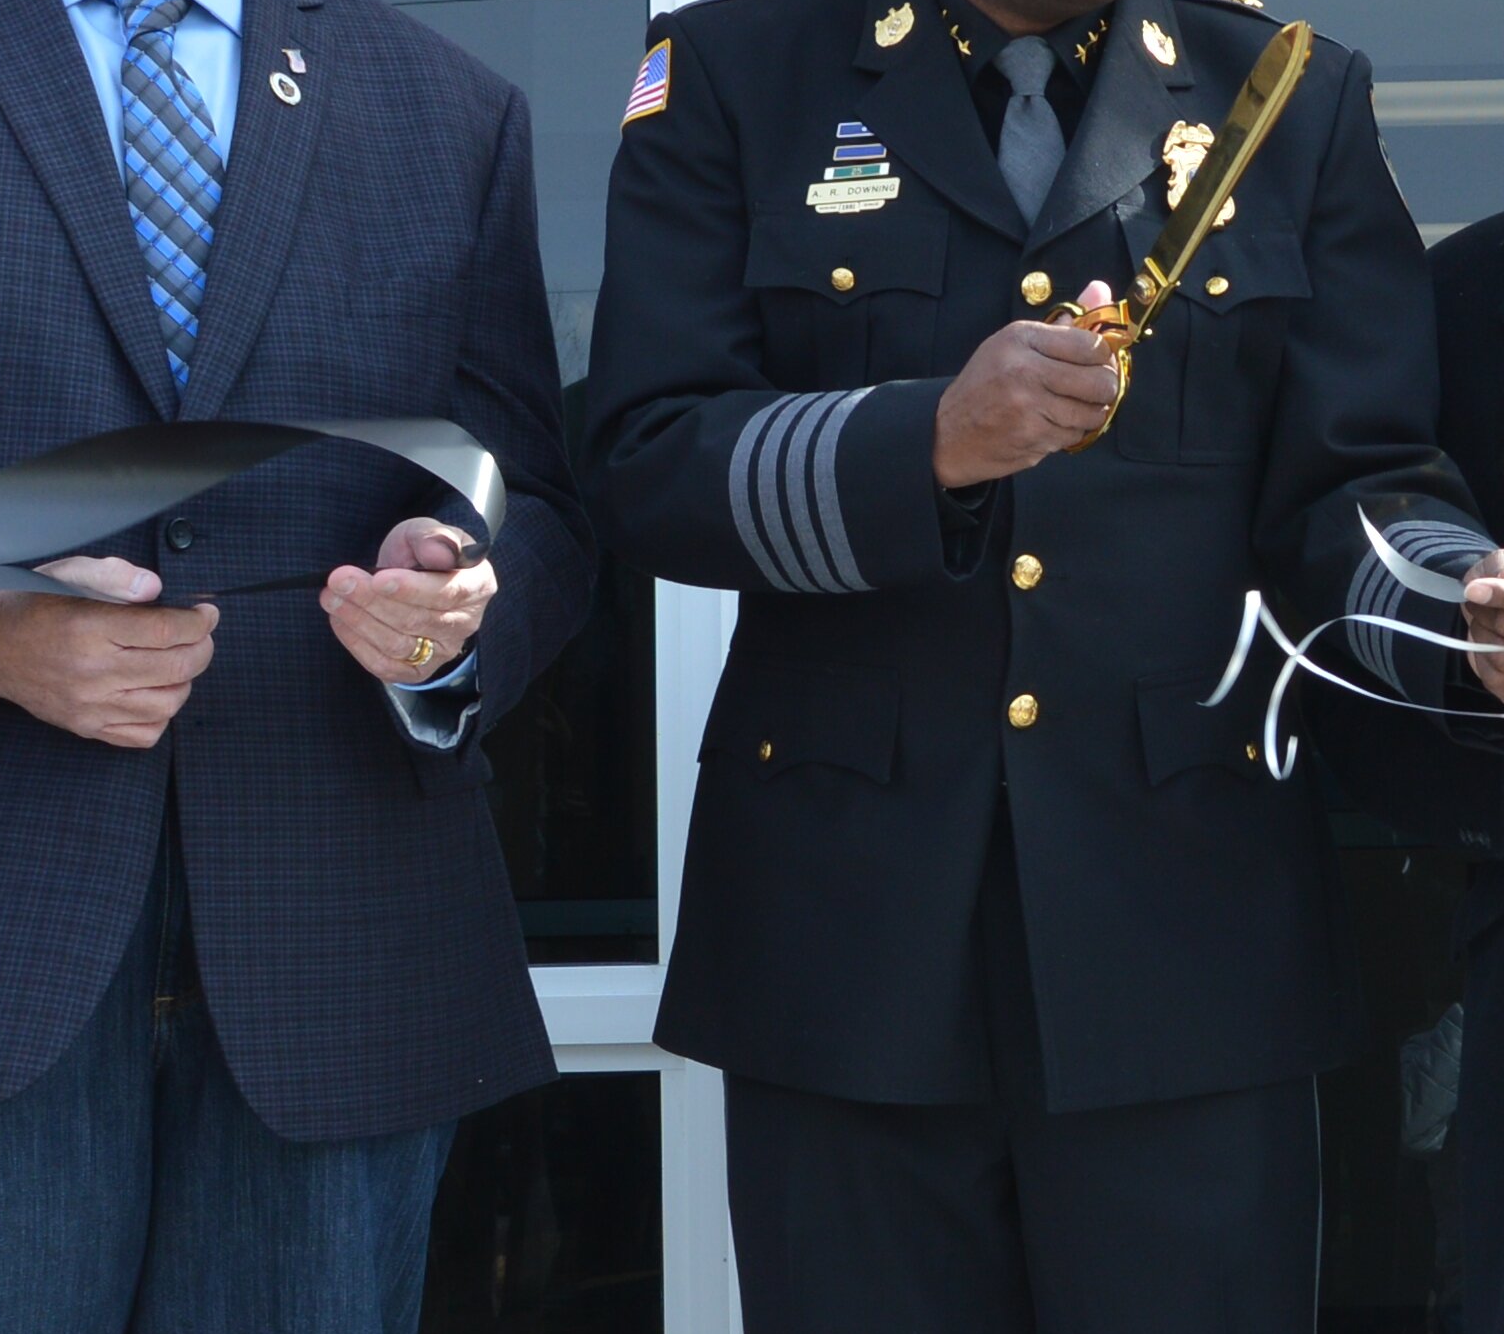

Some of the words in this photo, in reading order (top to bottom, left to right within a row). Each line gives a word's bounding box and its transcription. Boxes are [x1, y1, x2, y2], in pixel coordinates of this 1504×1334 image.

[812, 190, 822, 198] A.
[830, 188, 839, 196] R.
[847, 184, 896, 196] DOWNING
